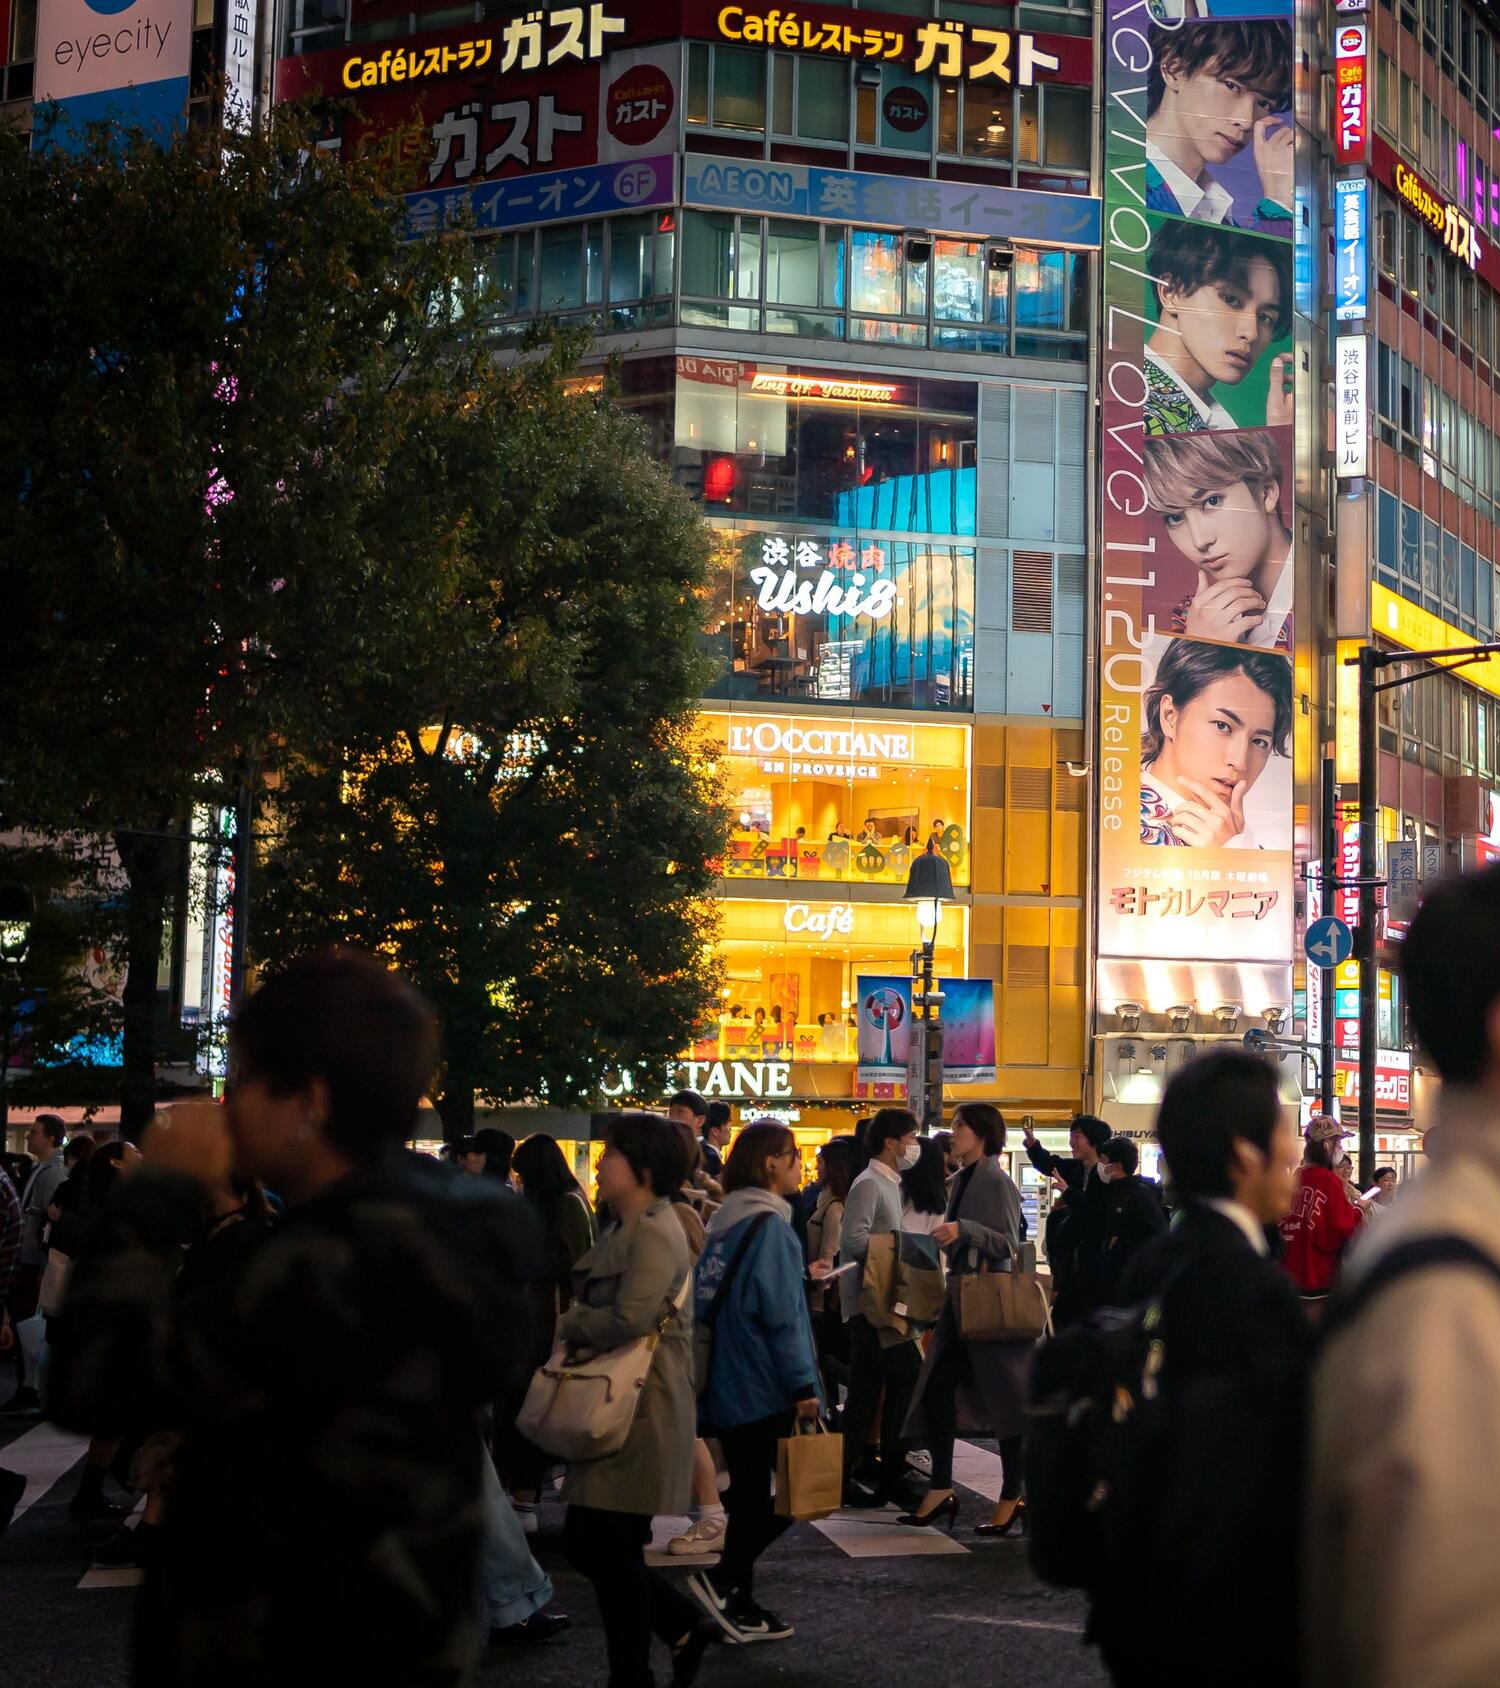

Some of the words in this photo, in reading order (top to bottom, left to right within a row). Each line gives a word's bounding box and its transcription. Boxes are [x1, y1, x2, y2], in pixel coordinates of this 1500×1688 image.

[55, 17, 174, 73] eyecity
[342, 38, 492, 90] Caféレストラン
[501, 3, 625, 74] ガスト
[717, 6, 904, 59] Caféレストラン
[914, 22, 1060, 87] ガスト
[428, 95, 582, 184] ガスト
[615, 98, 667, 125] ガスト
[888, 105, 925, 121] ガスト
[1340, 83, 1362, 151] ガスト
[1110, 0, 1186, 285] Revival
[618, 169, 650, 197] 6F
[701, 165, 795, 201] AEON
[819, 174, 1093, 235] 英会話イーオン
[1337, 181, 1365, 192] AEON
[1342, 194, 1361, 306] 英会話イーオン
[1443, 203, 1482, 270] ガスト
[1106, 305, 1183, 518] Love
[1342, 349, 1361, 466] 渋谷駅前ビル
[749, 565, 898, 620] Ushi8
[1102, 537, 1157, 693] 11.20
[731, 723, 910, 760] L'OCCITANE
[763, 762, 785, 775] EN
[791, 762, 879, 778] PROVENCE
[1102, 705, 1131, 831] Release
[783, 904, 854, 941] Café
[1109, 886, 1279, 921] モトカレマニア
